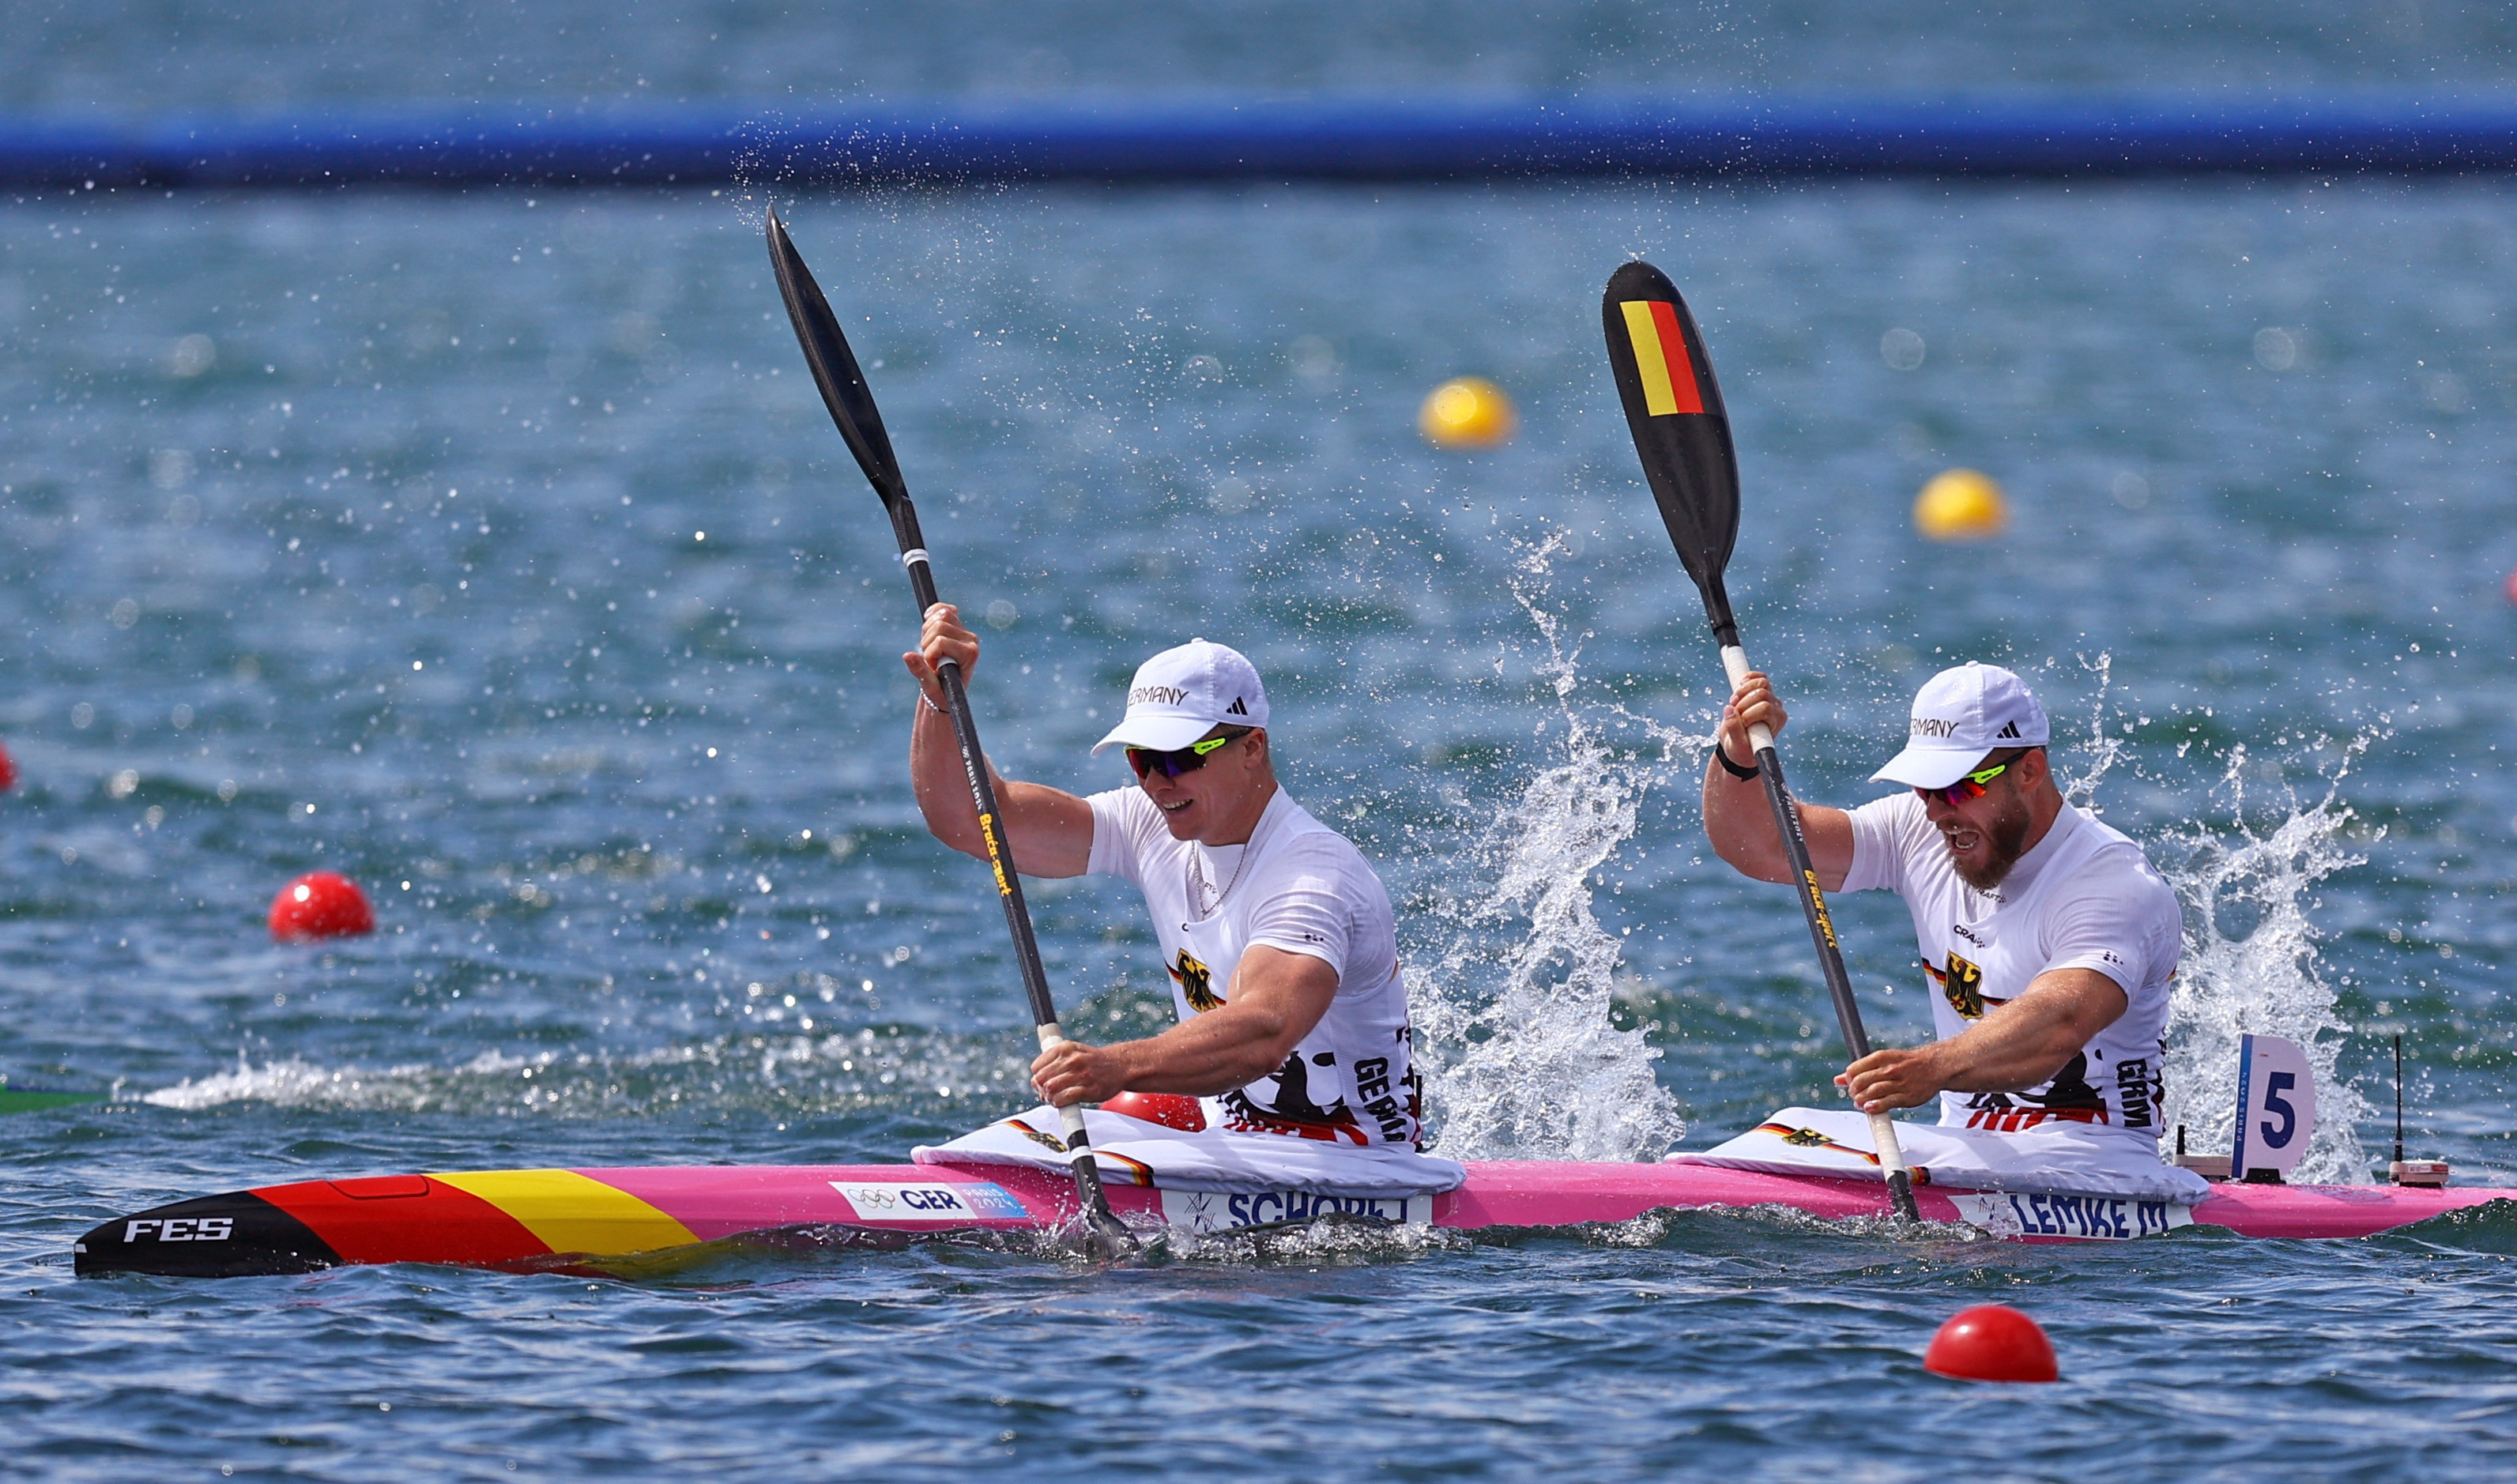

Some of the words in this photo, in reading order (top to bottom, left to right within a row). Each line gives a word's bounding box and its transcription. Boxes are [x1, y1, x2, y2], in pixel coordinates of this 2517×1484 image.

[966, 760, 977, 786] PARIS
[972, 786, 982, 811] 2024
[1977, 888, 2000, 901] RAFT
[2236, 1107, 2245, 1141] PARIS
[2260, 1071, 2296, 1149] 5
[899, 1190, 963, 1210] GER
[973, 1197, 1014, 1209] 2024
[123, 1218, 234, 1242] FES
[2010, 1193, 2131, 1238] LEMKE
[2137, 1200, 2169, 1236] M
